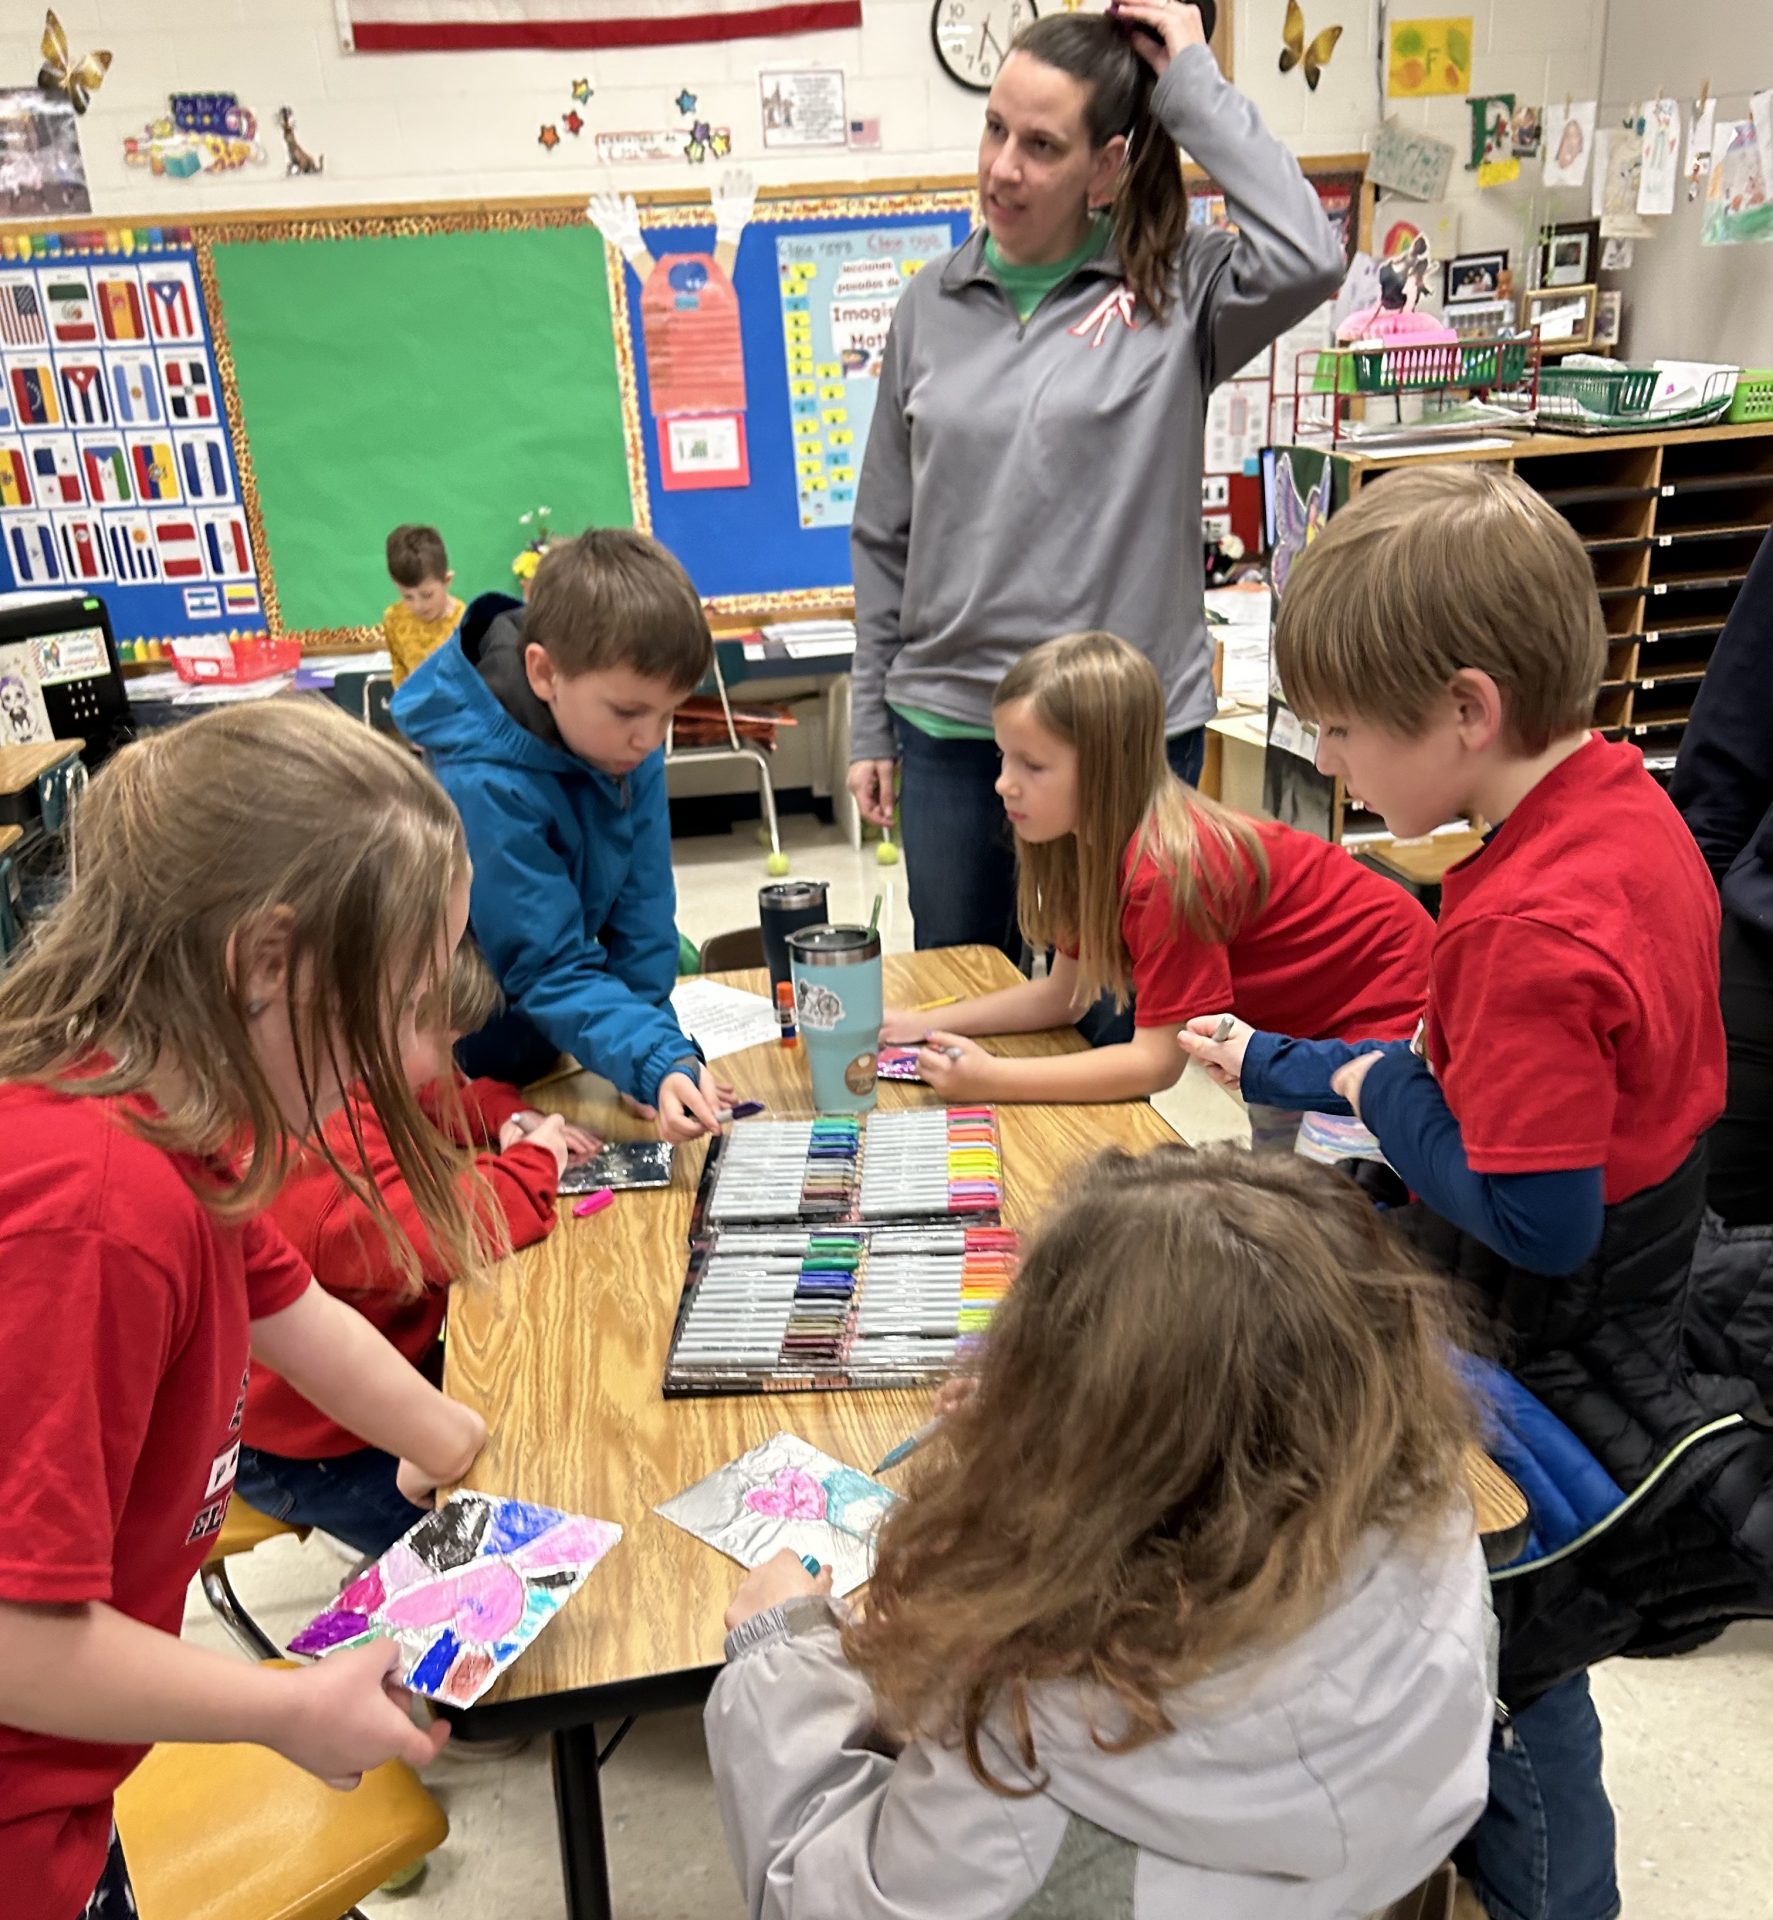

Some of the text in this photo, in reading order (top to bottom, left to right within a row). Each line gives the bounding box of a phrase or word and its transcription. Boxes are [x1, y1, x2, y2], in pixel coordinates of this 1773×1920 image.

[949, 3, 965, 19] 10
[966, 54, 975, 70] 7
[980, 61, 992, 78] 6
[1426, 47, 1441, 77] F
[1465, 94, 1516, 171] F
